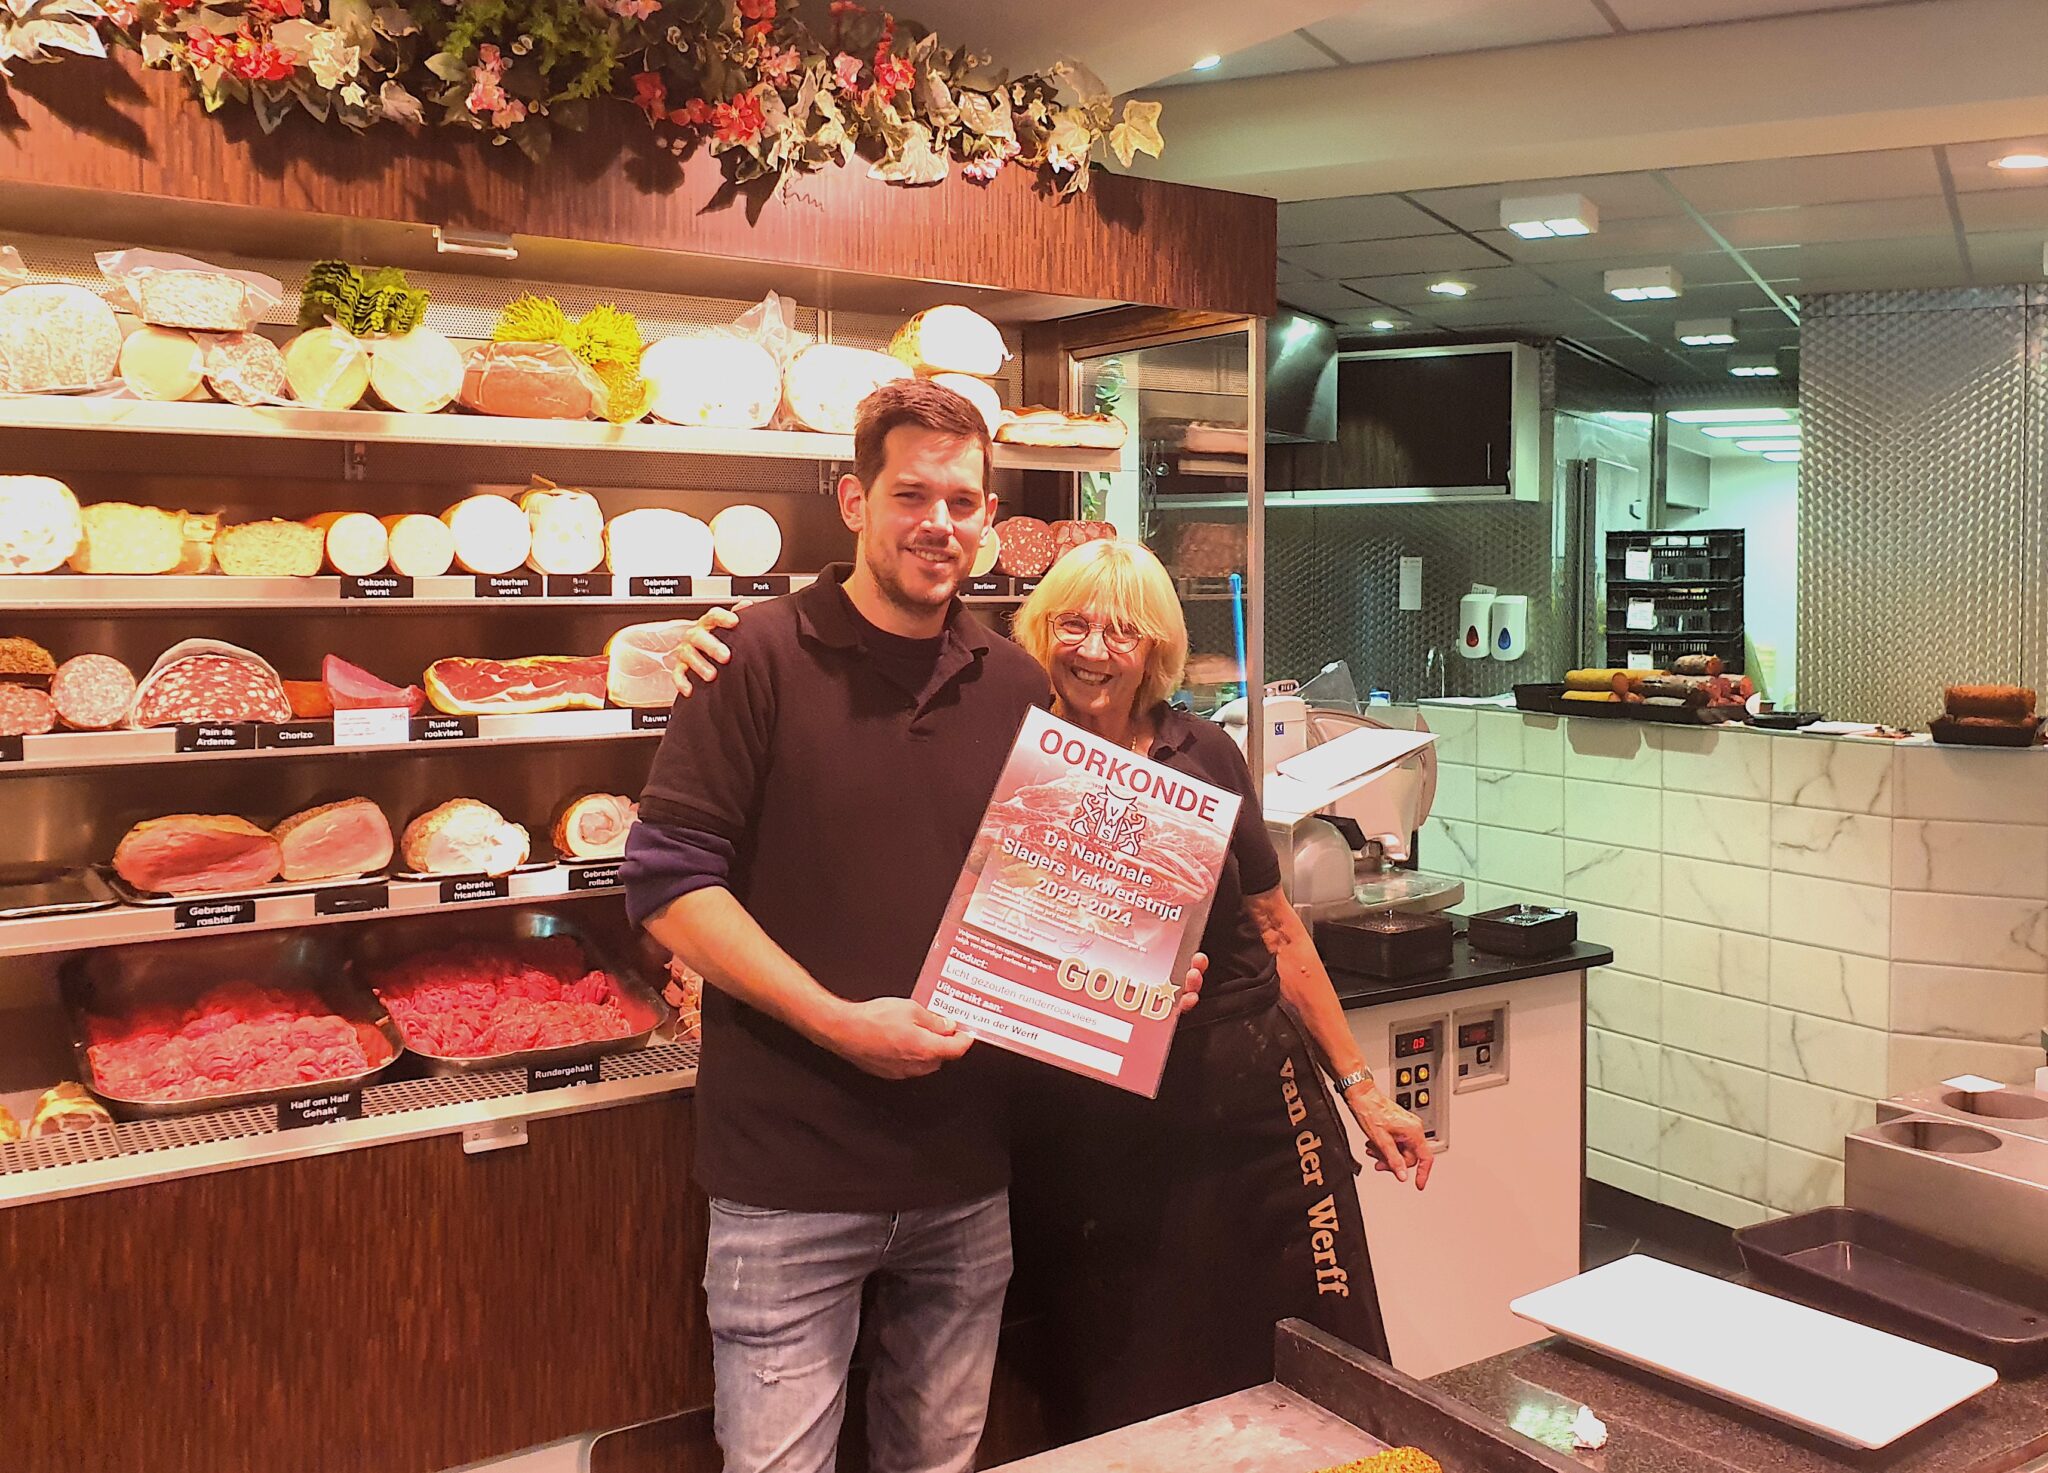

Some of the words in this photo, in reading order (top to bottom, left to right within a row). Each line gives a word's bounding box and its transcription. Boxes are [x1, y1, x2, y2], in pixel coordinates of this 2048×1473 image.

[357, 578, 398, 588] Gekookte
[490, 578, 529, 588] Boterham
[643, 578, 679, 587] Gebraden
[753, 582, 770, 591] Pork
[973, 582, 997, 590] Berliner
[365, 587, 391, 596] worst
[498, 587, 521, 596] worst
[428, 719, 459, 729] Runder
[642, 715, 667, 723] Rauwe
[199, 728, 217, 737] Pain
[278, 730, 314, 740] Chorizo
[424, 728, 464, 739] rookvlees
[196, 736, 237, 746] Ardenne
[1039, 728, 1219, 823] OORKONDE
[1043, 829, 1068, 852] De
[1070, 843, 1154, 888] Nationale
[583, 869, 619, 879] Gebraden
[1001, 837, 1066, 876] Slagers
[1070, 864, 1184, 922] VakWedstrijd
[455, 880, 494, 891] Gebraden
[588, 878, 614, 887] rollade
[453, 889, 496, 900] fricandeau
[1034, 876, 1133, 929] 2023-2024
[189, 903, 241, 916] Gebraden
[196, 914, 236, 927] rosbief
[949, 945, 989, 970] Product:
[946, 963, 970, 981] Licht
[969, 972, 1016, 999] gezouten
[1018, 990, 1098, 1026] runderrookvlees
[1056, 956, 1173, 1021] GOUD
[935, 979, 982, 1007] Uitgereikt
[983, 998, 1004, 1014] aan:
[932, 996, 971, 1020] Slagerij
[972, 1013, 990, 1025] van
[992, 1016, 1009, 1032] der
[1011, 1023, 1039, 1041] Werff
[534, 1062, 593, 1080] Rundergehakt
[1280, 1056, 1308, 1127] van
[290, 1098, 311, 1110] Half
[312, 1097, 328, 1108] om
[330, 1093, 350, 1105] Half
[302, 1105, 338, 1119] Gehakt
[1295, 1130, 1324, 1187] der
[1307, 1193, 1350, 1299] Werff
